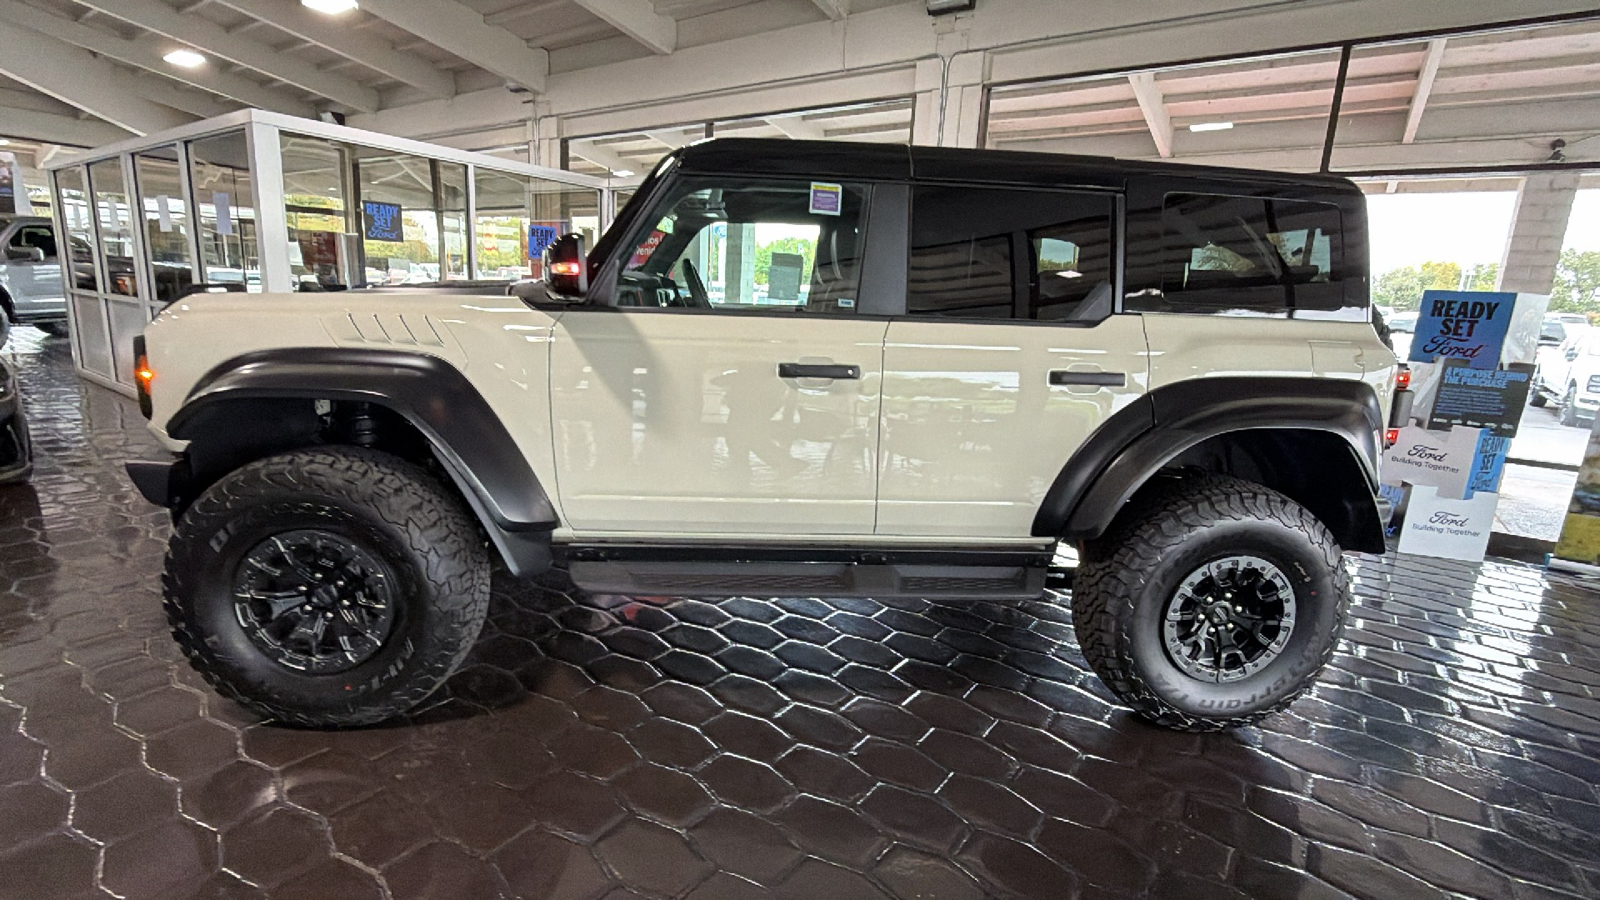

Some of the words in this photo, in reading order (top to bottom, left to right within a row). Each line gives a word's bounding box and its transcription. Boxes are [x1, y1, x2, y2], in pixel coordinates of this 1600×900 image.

[366, 202, 398, 217] READY
[373, 213, 392, 227] SET
[367, 226, 398, 239] Ford
[531, 227, 554, 238] READY
[536, 236, 548, 247] SET
[1430, 299, 1500, 320] READY
[1439, 318, 1480, 337] SET
[1423, 335, 1482, 358] Ford
[1452, 367, 1494, 379] PURPOSE
[1444, 375, 1460, 385] THE
[1461, 377, 1508, 389] PURCHASE
[1407, 444, 1448, 463] Ford
[1480, 437, 1505, 454] READY
[1391, 455, 1422, 468] Building
[1425, 461, 1460, 474] Together
[1480, 453, 1497, 470] SET
[1471, 471, 1496, 491] Ford
[1429, 511, 1469, 528] Ford
[1412, 523, 1444, 534] Building
[1446, 527, 1481, 538] Together
